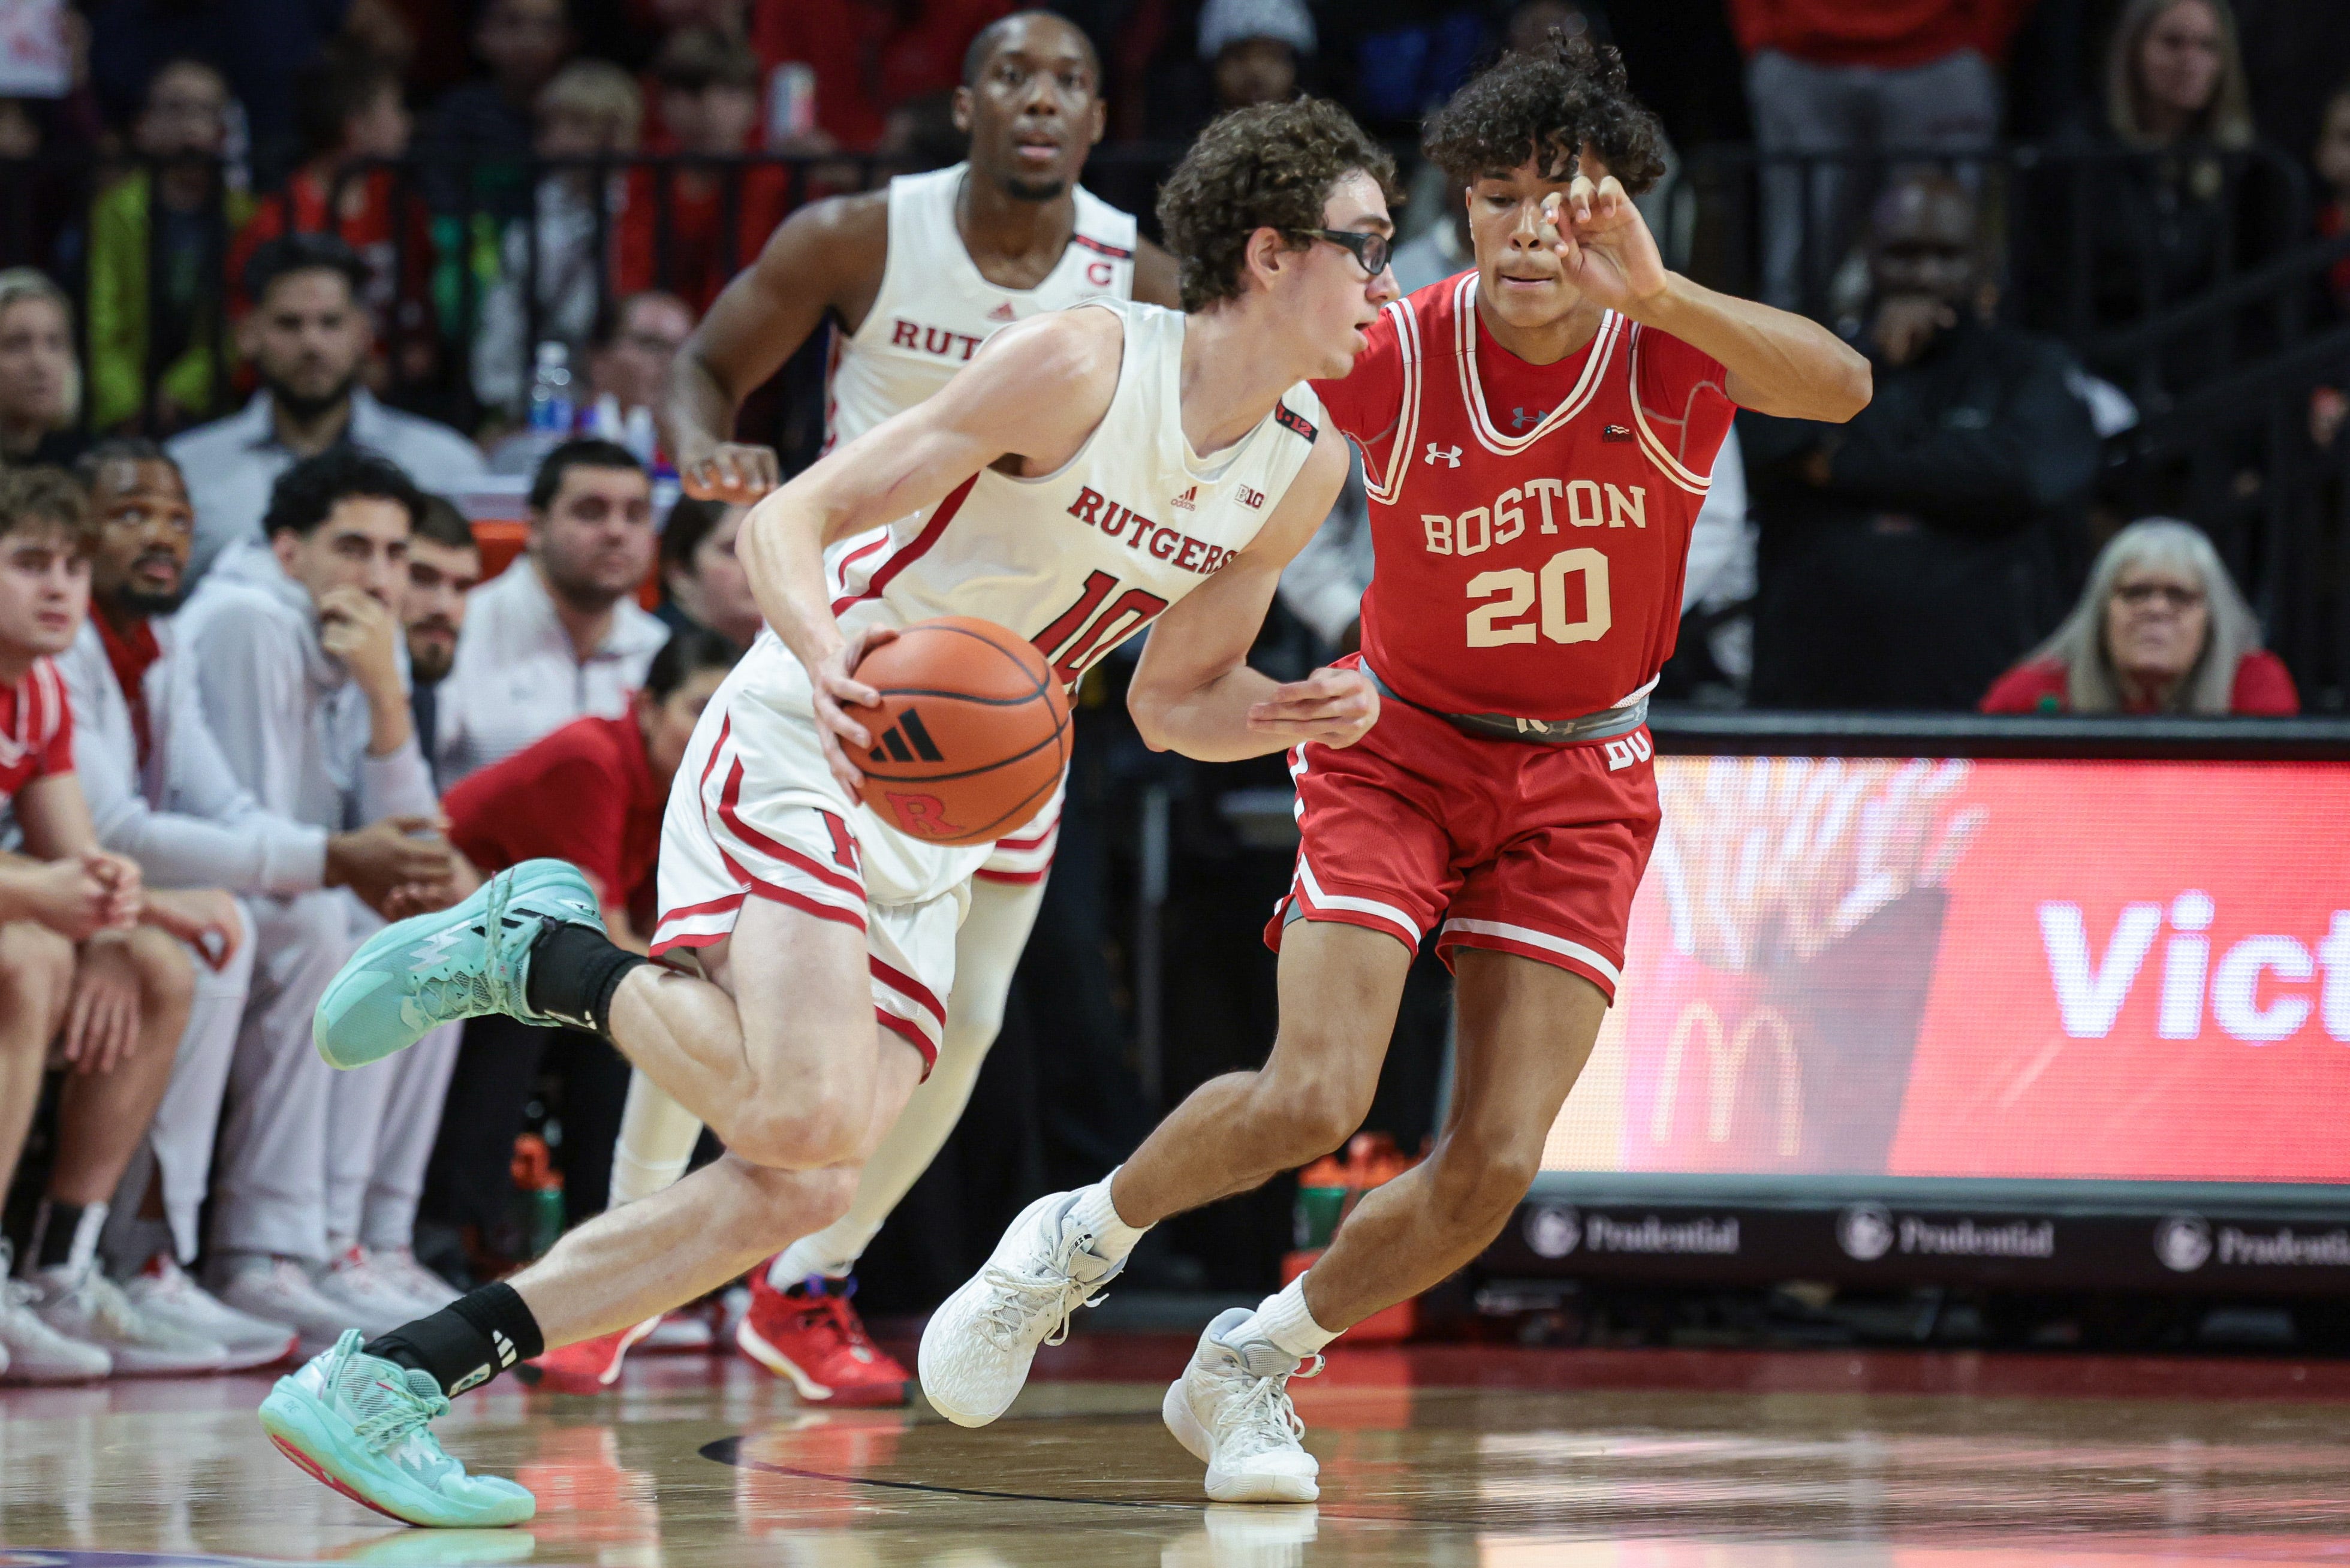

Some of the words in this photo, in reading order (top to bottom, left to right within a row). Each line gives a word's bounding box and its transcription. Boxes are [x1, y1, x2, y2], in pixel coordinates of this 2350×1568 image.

[1087, 263, 1111, 287] C
[892, 320, 984, 361] RUT
[1066, 486, 1239, 575] RUTGERS
[1420, 478, 1646, 556] BOSTON
[1466, 547, 1611, 647] 20
[1030, 569, 1169, 685] 10
[885, 792, 965, 836] R
[2036, 889, 2350, 1044] Vict
[1586, 1215, 1739, 1253] Prudential
[1899, 1217, 2054, 1256] Prudential
[2218, 1228, 2350, 1265] Prudenti
